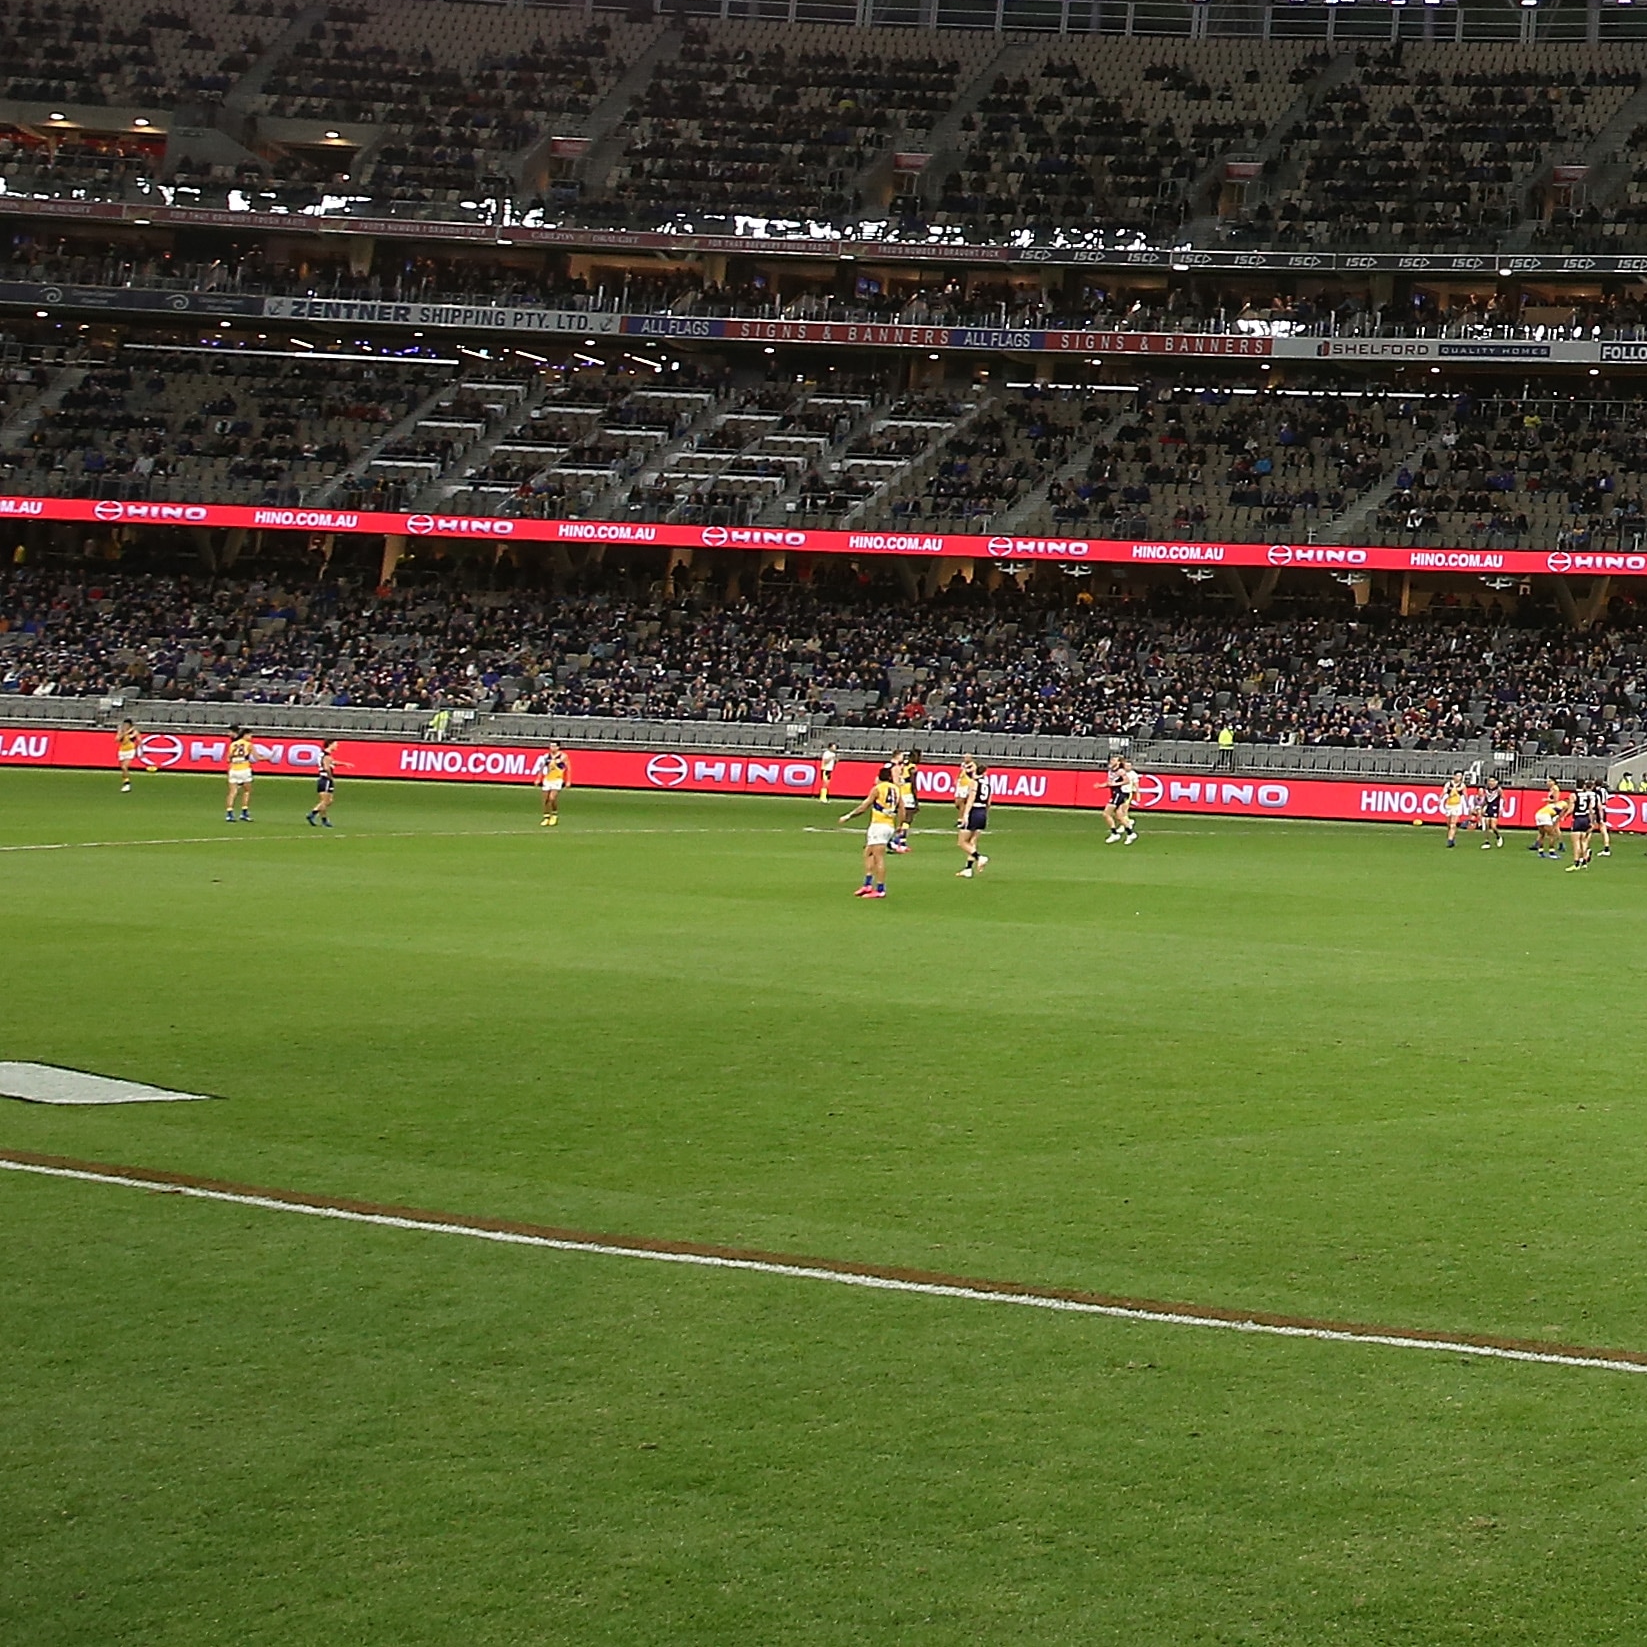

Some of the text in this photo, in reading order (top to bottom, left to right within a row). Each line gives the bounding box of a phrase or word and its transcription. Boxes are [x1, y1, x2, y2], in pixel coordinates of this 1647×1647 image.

[291, 304, 593, 331] ZENTNER SHIPPING PTY. LTD.
[641, 320, 710, 336] ALL FLAGS
[740, 323, 949, 345] SIGNS & BANNERS
[963, 331, 1031, 348] ALL FLAGS
[1061, 334, 1264, 354] SIGNS & BANNERS
[1333, 343, 1549, 356] SHELFORD QUALITY HOMES
[127, 505, 207, 520] HINO
[254, 510, 358, 528] HINO.COM.AU
[437, 518, 514, 534] HINO
[558, 524, 656, 541] HINO.COM.AU
[731, 530, 806, 546] HINO
[848, 535, 943, 552] HINO.COM.AU
[1015, 540, 1089, 555] HINO
[1132, 545, 1224, 561] HINO.COM.AU
[1295, 549, 1367, 563] HINO
[1410, 552, 1504, 568] HINO.COM.AU
[1574, 555, 1646, 570] HINO
[190, 740, 321, 766] HNO
[400, 750, 547, 776] HINO.COM.A
[694, 761, 816, 786] HINO
[979, 782, 988, 801] 9
[1169, 781, 1289, 807] HINO
[1578, 796, 1588, 811] 5
